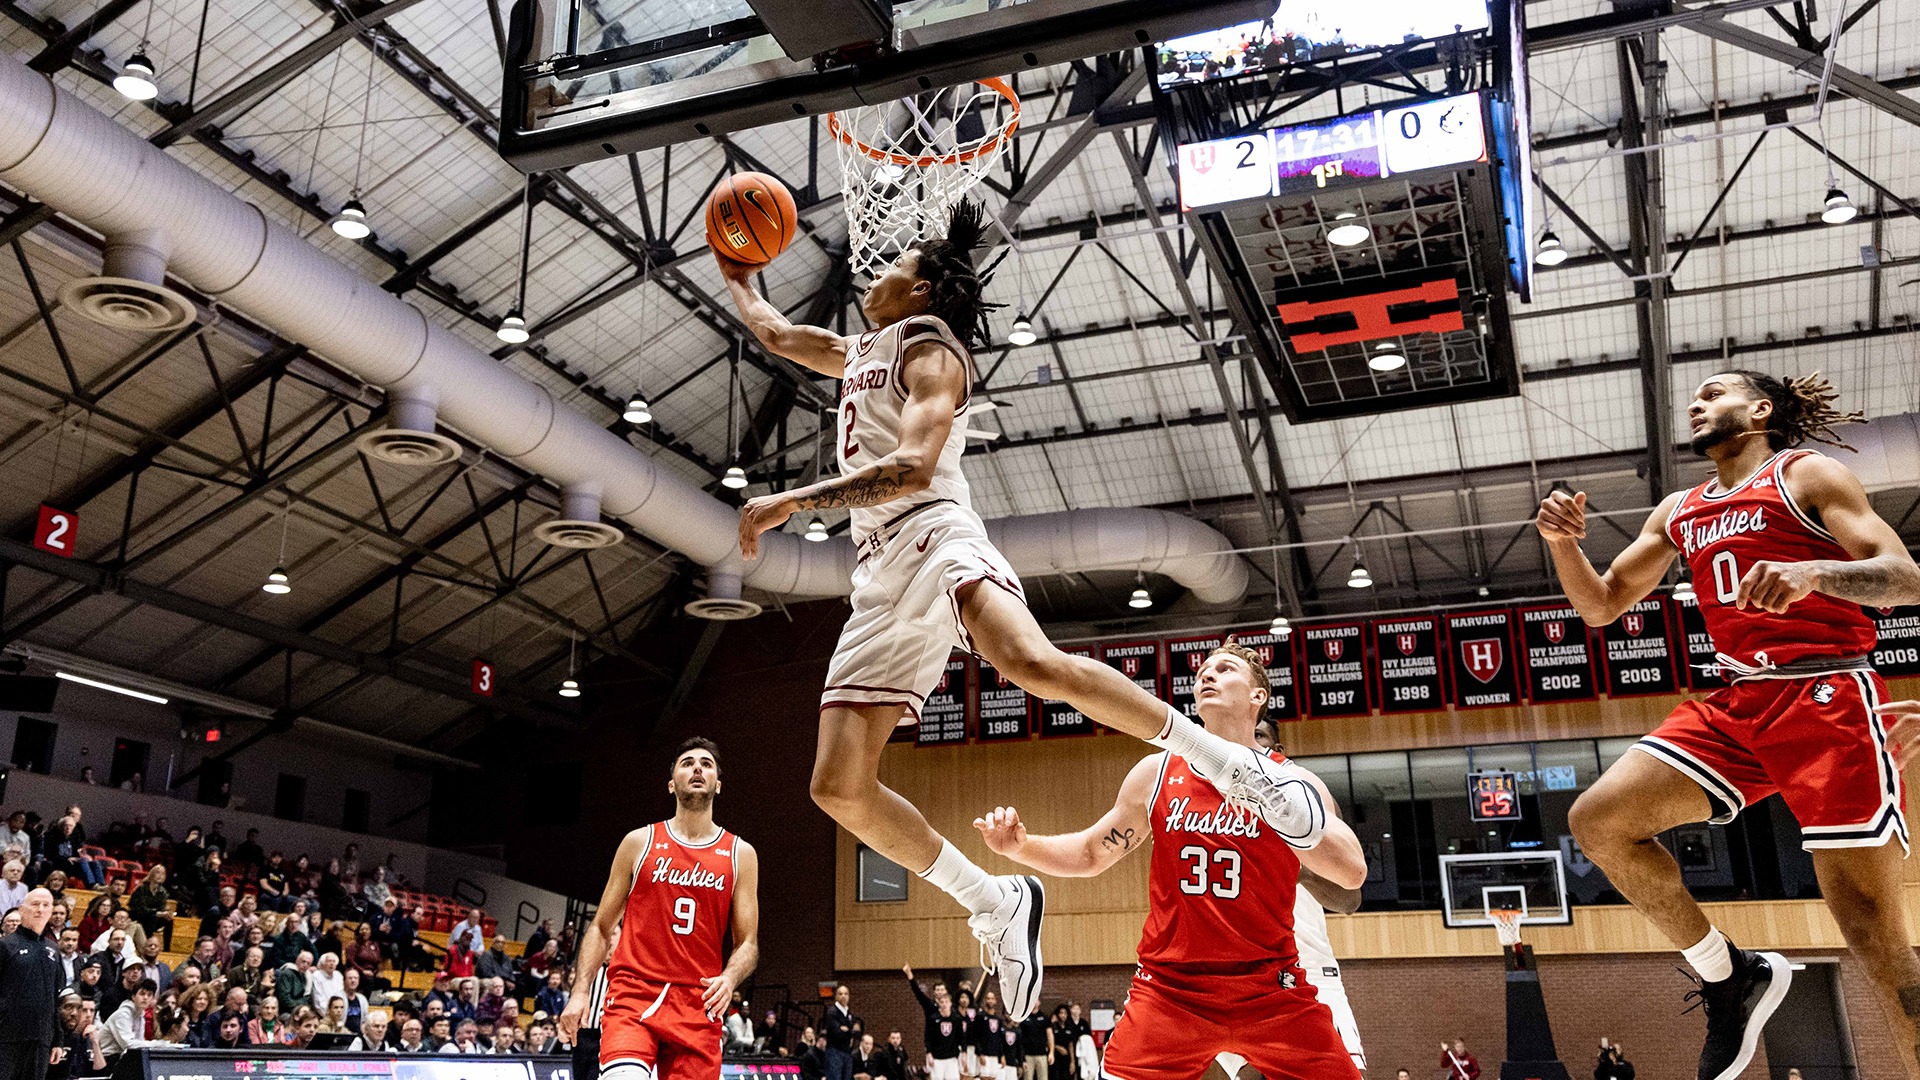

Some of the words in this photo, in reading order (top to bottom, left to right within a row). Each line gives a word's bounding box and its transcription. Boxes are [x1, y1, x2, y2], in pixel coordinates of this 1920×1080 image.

[1400, 111, 1421, 139] 0
[1277, 117, 1371, 159] 17:31
[1235, 140, 1257, 169] 2
[1311, 160, 1344, 188] 1ST
[719, 200, 750, 248] ELITE
[844, 401, 860, 460] 2
[1752, 477, 1772, 488] CAA
[46, 514, 69, 549] 2
[1680, 504, 1768, 558] Huskies
[1712, 550, 1740, 604] 0
[1378, 621, 1433, 634] HARVARD
[1451, 614, 1506, 628] HARVARD
[1878, 616, 1920, 629] LEAGUE
[1238, 633, 1288, 646] HARVARD
[1307, 627, 1359, 639] HARVARD
[1688, 633, 1706, 643] IVY
[1171, 640, 1220, 652] HARVARD
[1607, 640, 1624, 650] IVY
[1627, 637, 1665, 649] LEAGUE
[1106, 646, 1154, 657] HARVARD
[1530, 647, 1546, 658] IVY
[1548, 644, 1585, 656] LEAGUE
[1608, 647, 1667, 660] CHAMPIONS
[1873, 648, 1919, 665] 2008
[1382, 659, 1398, 669] IVY
[1400, 656, 1435, 667] LEAGUE
[1530, 654, 1587, 667] CHAMPIONS
[1310, 664, 1325, 674] IVY
[1327, 662, 1361, 673] LEAGUE
[1382, 666, 1437, 679] CHAMPIONS
[1702, 662, 1720, 677] 20
[479, 665, 490, 691] 3
[1173, 676, 1188, 686] IVY
[1310, 671, 1362, 683] CHAMPIONS
[1541, 674, 1581, 690] 2002
[1620, 668, 1661, 684] 2003
[981, 691, 994, 700] IVY
[996, 689, 1025, 699] LEAGUE
[1320, 690, 1354, 705] 1997
[1393, 685, 1430, 701] 1998
[1465, 693, 1510, 705] WOMEN
[929, 695, 954, 705] NCAA
[981, 698, 1026, 709] TOURNAMENT
[943, 713, 964, 721] 1997
[980, 707, 1026, 718] CHAMPIONS
[1051, 712, 1083, 725] 1986
[988, 721, 1019, 734] 1986
[943, 731, 964, 740] 2007
[1481, 792, 1511, 816] 25
[1165, 797, 1261, 838] Huskies
[652, 856, 725, 891] Huskies
[1180, 846, 1241, 899] 33
[672, 897, 696, 935] 9
